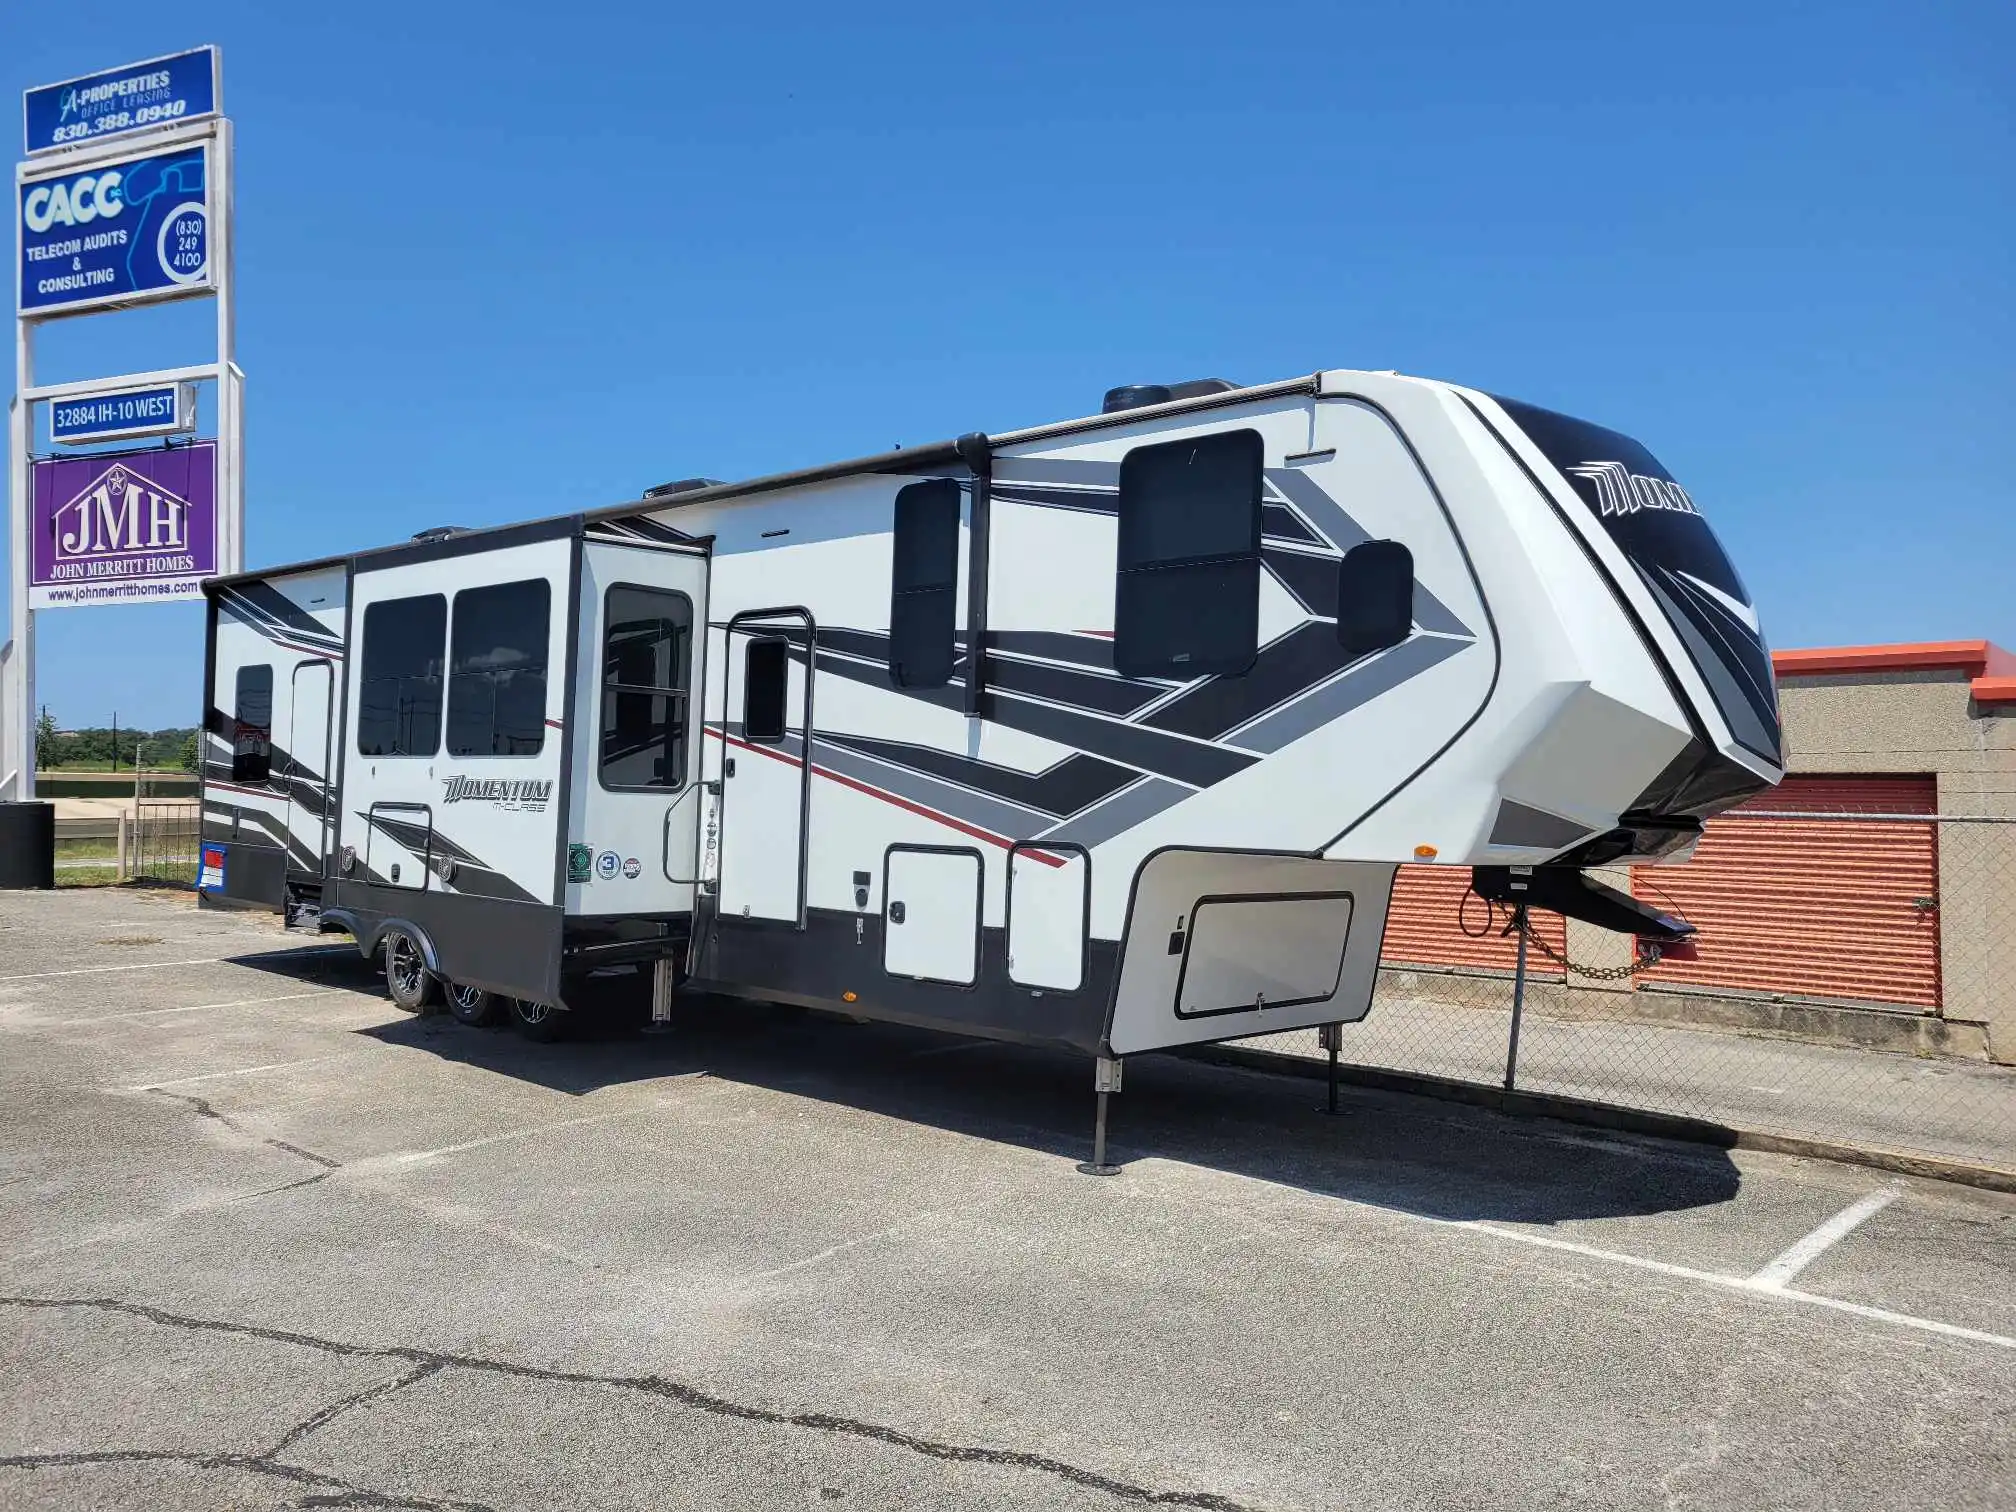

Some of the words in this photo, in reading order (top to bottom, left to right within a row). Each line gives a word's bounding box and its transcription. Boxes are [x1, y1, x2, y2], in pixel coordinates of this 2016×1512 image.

[52, 99, 186, 142] 830.388.0940
[81, 99, 116, 119] OFFICE
[25, 171, 124, 233] CACC
[176, 219, 202, 236] (830)
[26, 239, 81, 261] TELECOM
[83, 229, 127, 251] AUDITS
[179, 236, 198, 251] 249
[72, 257, 82, 271] &
[174, 252, 201, 267] 4100
[38, 267, 115, 294] CONSULTING
[57, 405, 96, 428] 32884
[98, 401, 134, 423] IH-10
[135, 395, 173, 417] WEST
[62, 483, 182, 554] JMH
[50, 562, 85, 580] JOHN
[86, 558, 144, 577] MERRITT
[146, 555, 194, 573] HOMES
[48, 581, 198, 602] www.johnmerritthomes.com
[441, 774, 553, 804] MOMENTUM
